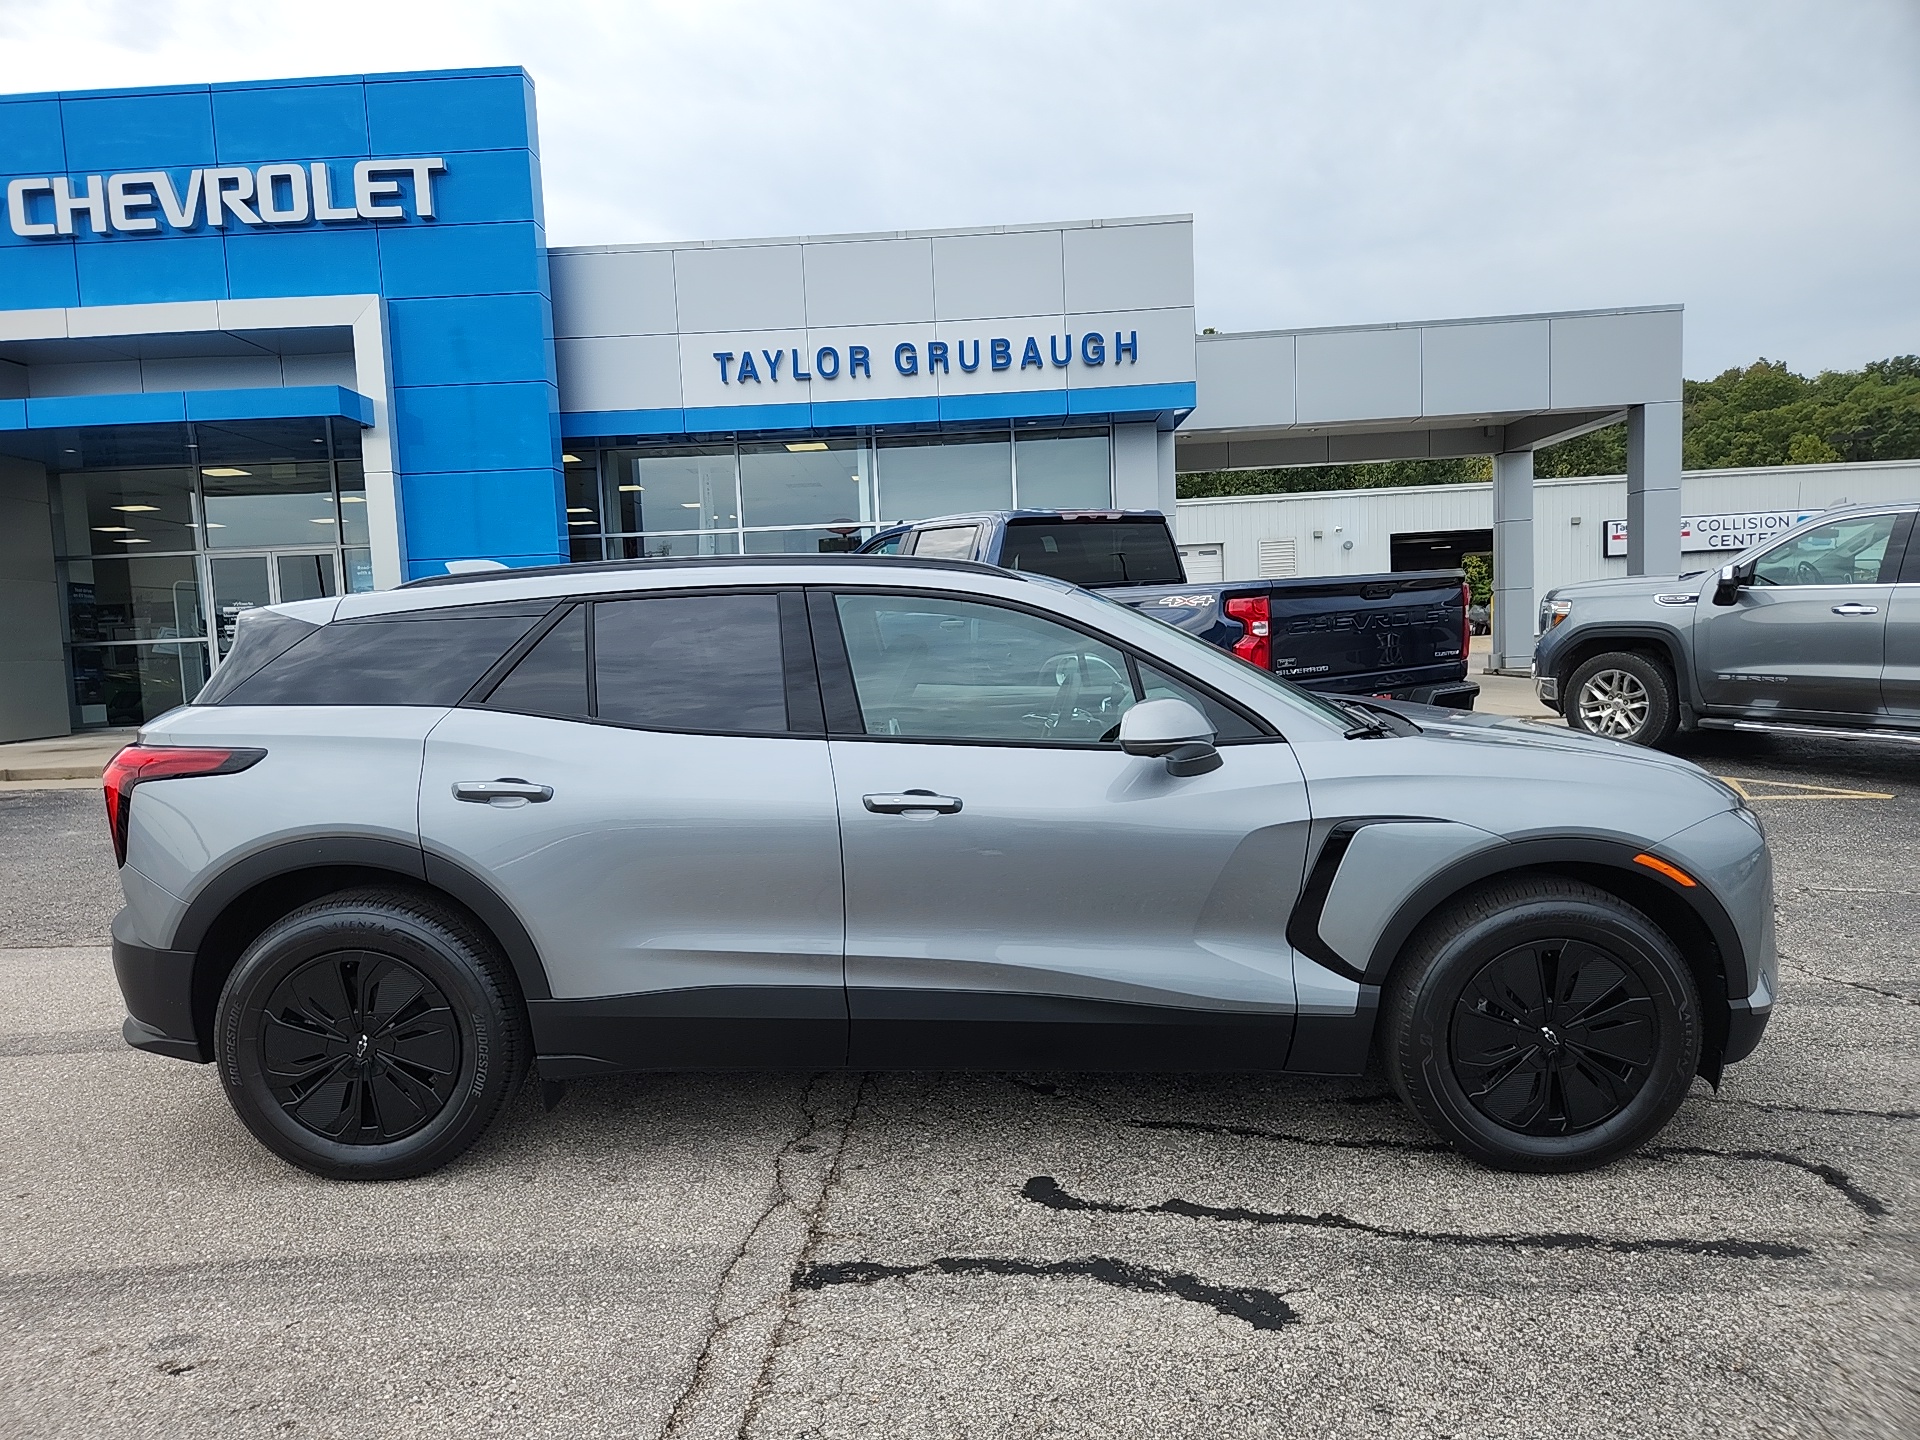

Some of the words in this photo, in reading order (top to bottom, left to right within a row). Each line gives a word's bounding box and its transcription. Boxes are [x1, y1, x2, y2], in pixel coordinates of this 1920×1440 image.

[7, 157, 447, 237] CHEVROLET
[712, 345, 872, 384] TAYLOR
[893, 330, 1139, 375] GRUBAUGH
[1697, 515, 1790, 533] COLLISION
[1287, 608, 1453, 636] CHEVROLET
[1275, 665, 1329, 676] SILVERADO
[225, 1000, 243, 1087] BRIDGESTONE
[472, 1013, 489, 1098] BRIDGESTONE
